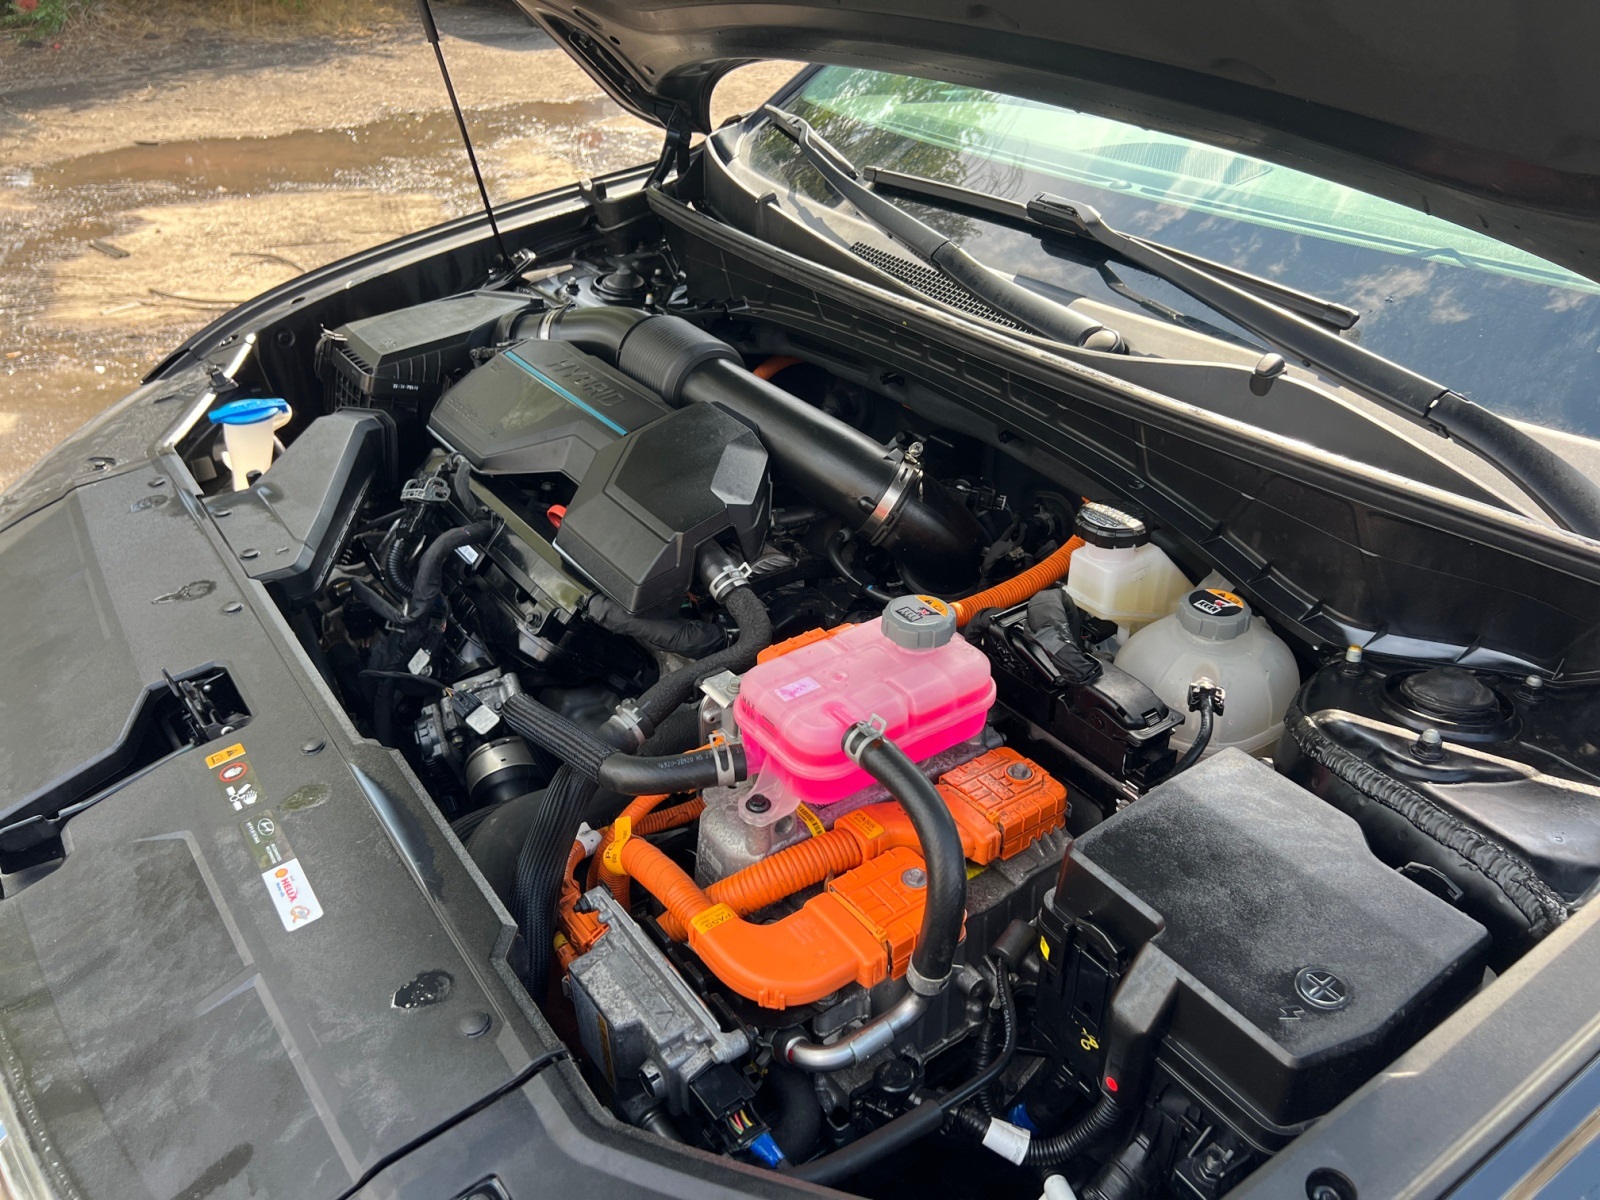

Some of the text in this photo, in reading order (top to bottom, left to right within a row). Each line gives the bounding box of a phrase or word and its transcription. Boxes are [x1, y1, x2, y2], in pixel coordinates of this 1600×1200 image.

[545, 359, 627, 407] HYBRID
[742, 695, 755, 710] MAX
[856, 813, 875, 829] PASS
[281, 878, 298, 902] HELIX
[705, 912, 732, 929] PASS
